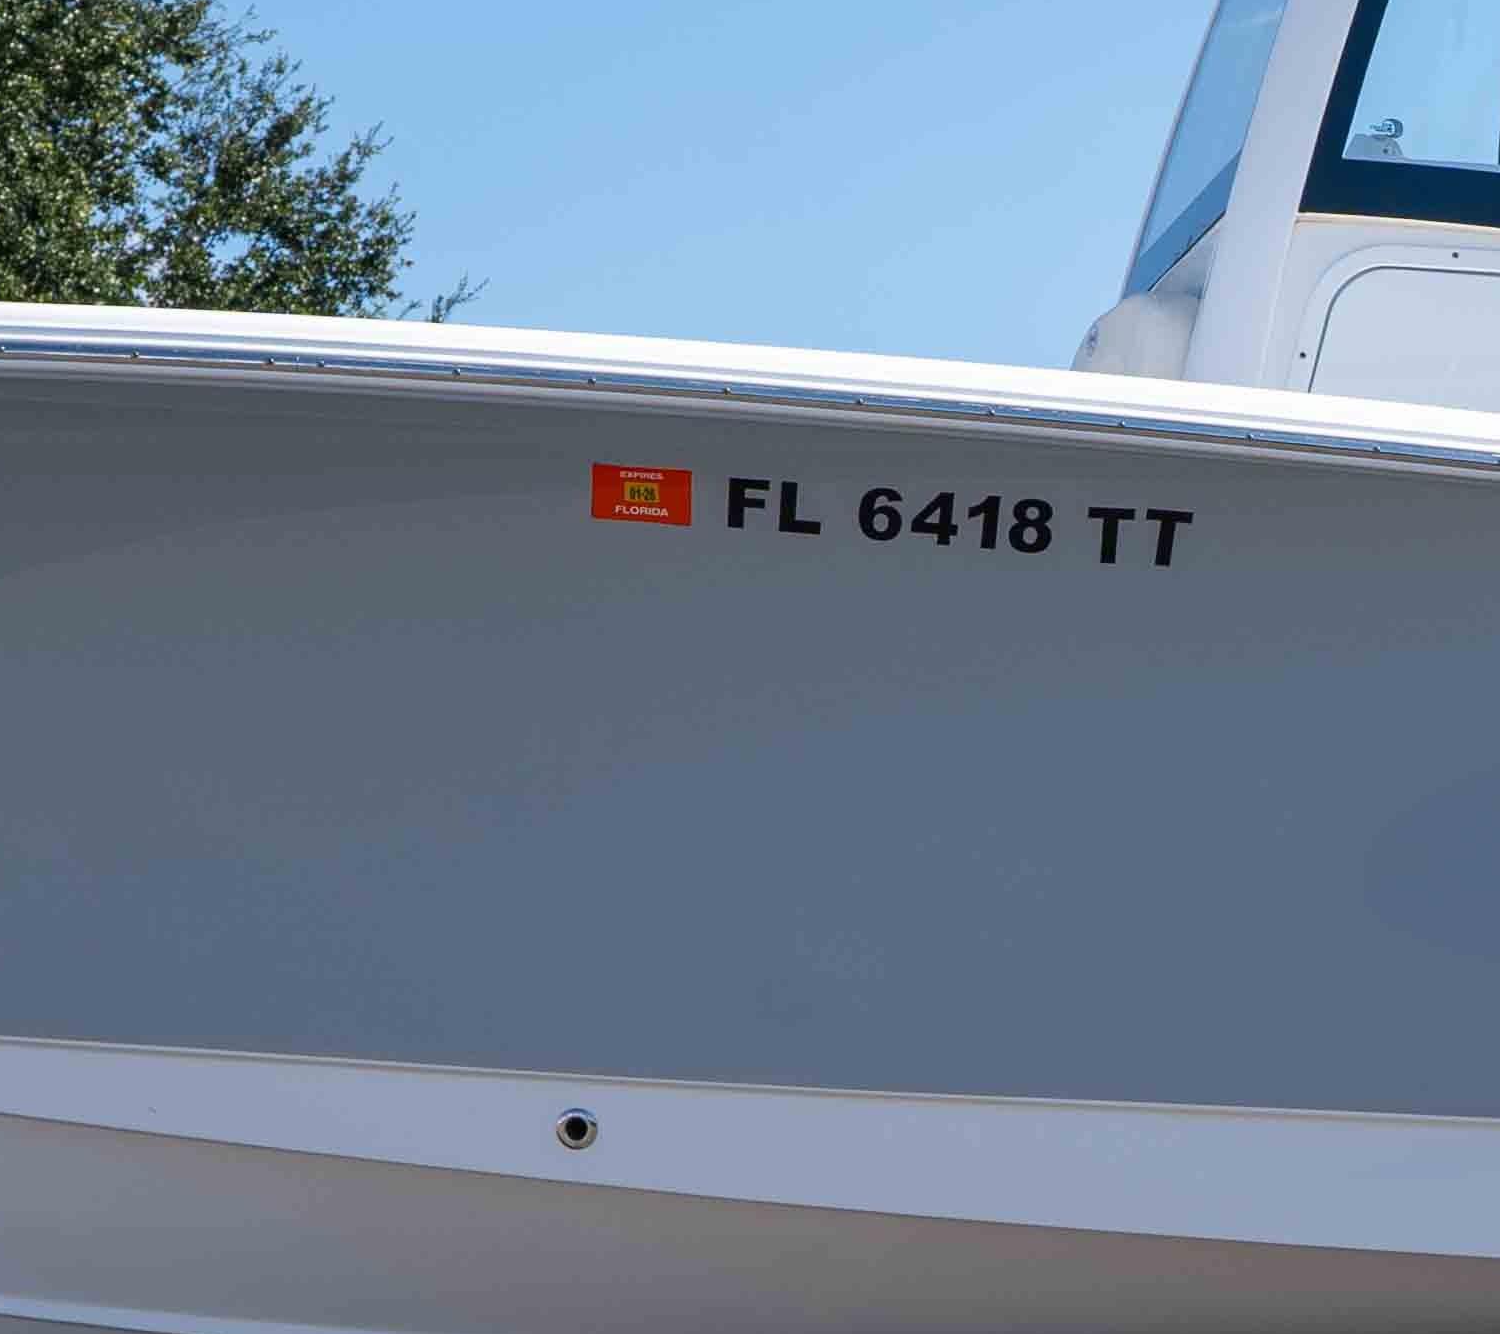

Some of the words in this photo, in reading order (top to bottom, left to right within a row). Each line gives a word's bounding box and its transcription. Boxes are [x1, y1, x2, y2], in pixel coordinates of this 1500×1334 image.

[614, 504, 669, 518] FLORIDA
[727, 477, 821, 535] FL
[858, 487, 1054, 554] 6418
[1087, 506, 1194, 567] TT
